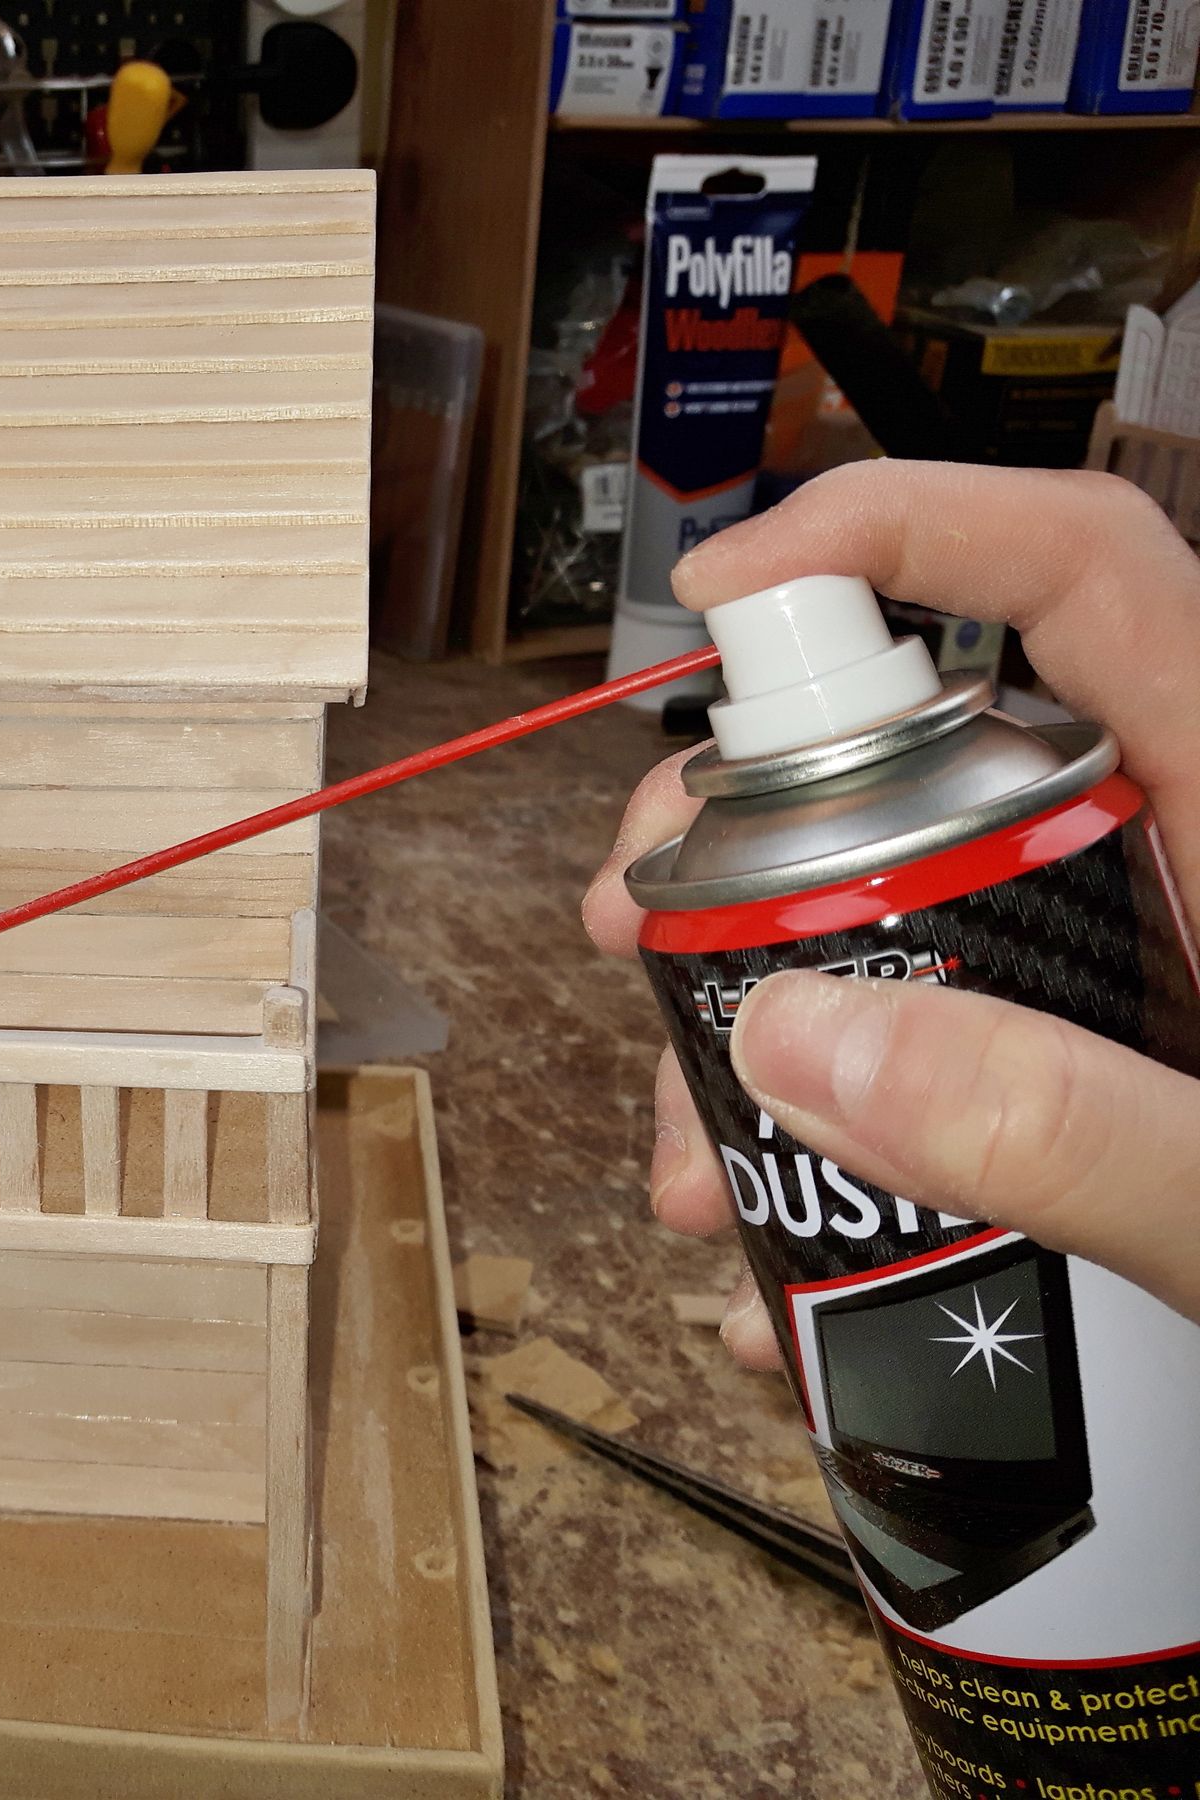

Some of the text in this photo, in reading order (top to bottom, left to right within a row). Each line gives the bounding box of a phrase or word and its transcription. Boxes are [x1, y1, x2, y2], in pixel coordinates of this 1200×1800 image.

[665, 233, 793, 310] Polyfilla
[897, 1645, 1199, 1717] helps clean & protect
[982, 1709, 1150, 1746] equipment
